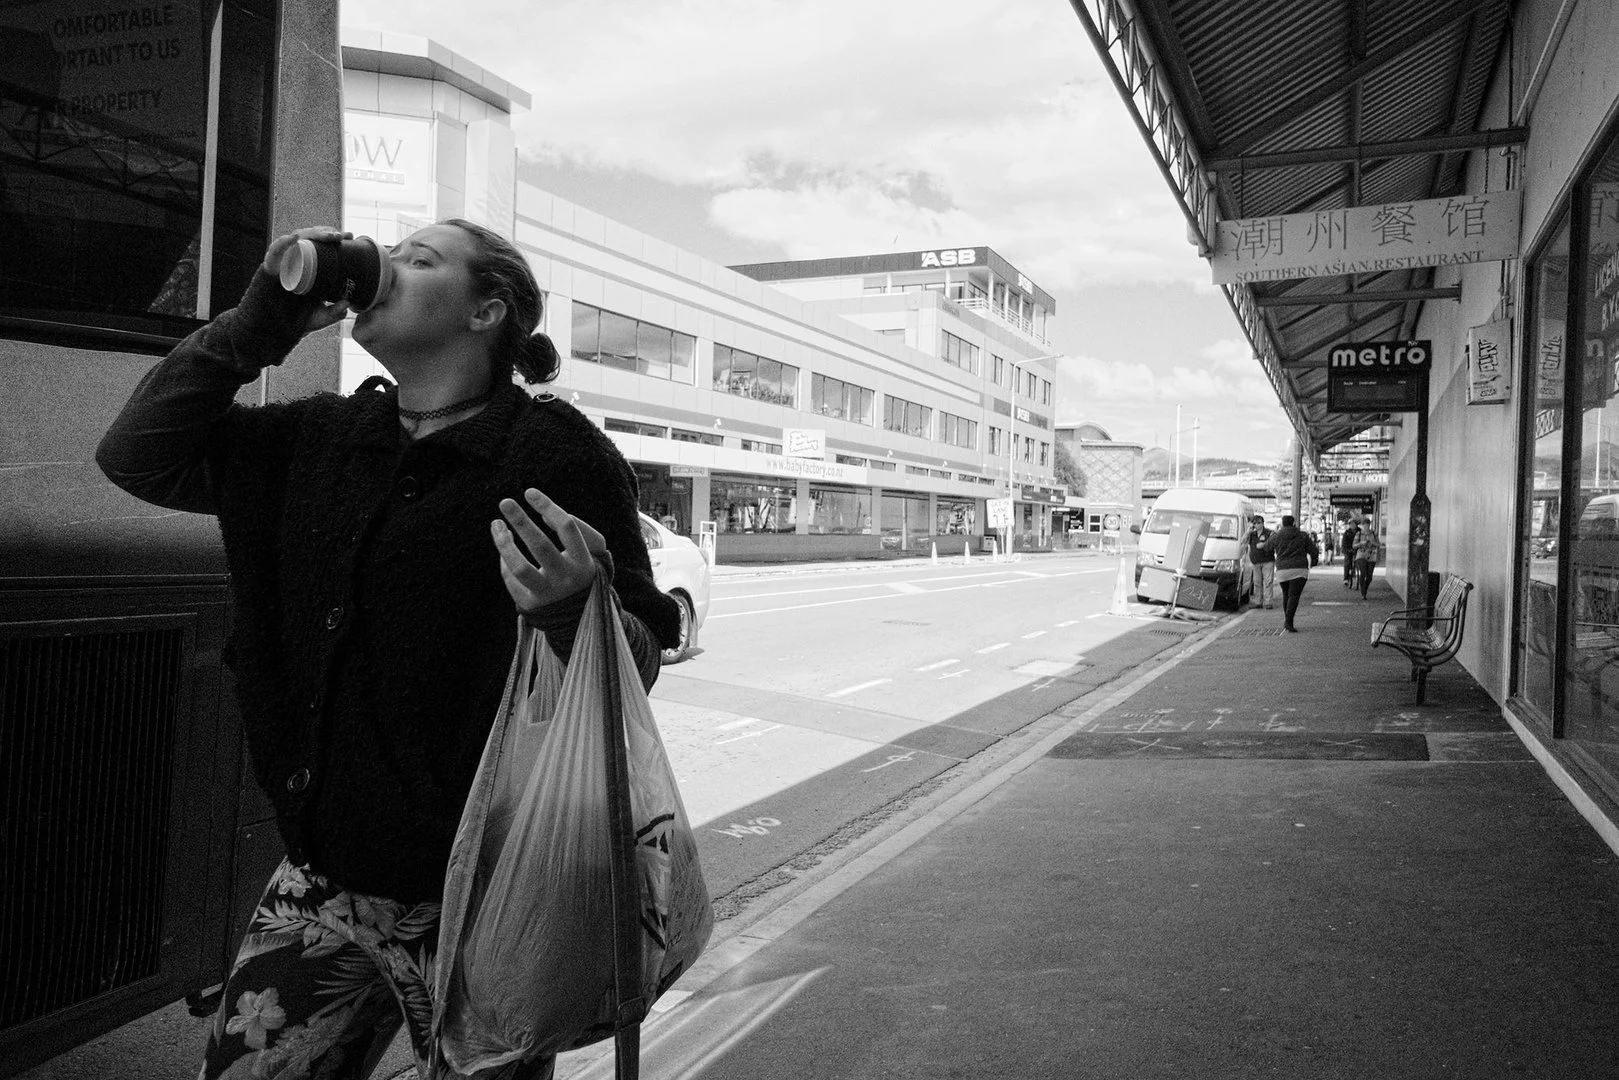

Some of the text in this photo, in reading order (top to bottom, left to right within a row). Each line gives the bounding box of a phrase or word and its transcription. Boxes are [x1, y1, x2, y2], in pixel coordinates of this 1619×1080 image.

[127, 42, 153, 61] TO
[158, 38, 181, 60] US
[72, 88, 163, 116] PROPERTY
[1231, 196, 1489, 261] 潮州餐馆
[921, 249, 976, 268] ASB
[1235, 264, 1318, 283] SOUTHERN
[1374, 250, 1486, 270] RESTAURANT
[1332, 345, 1426, 367] metro
[766, 458, 843, 478] www.babyfactory.co.nz
